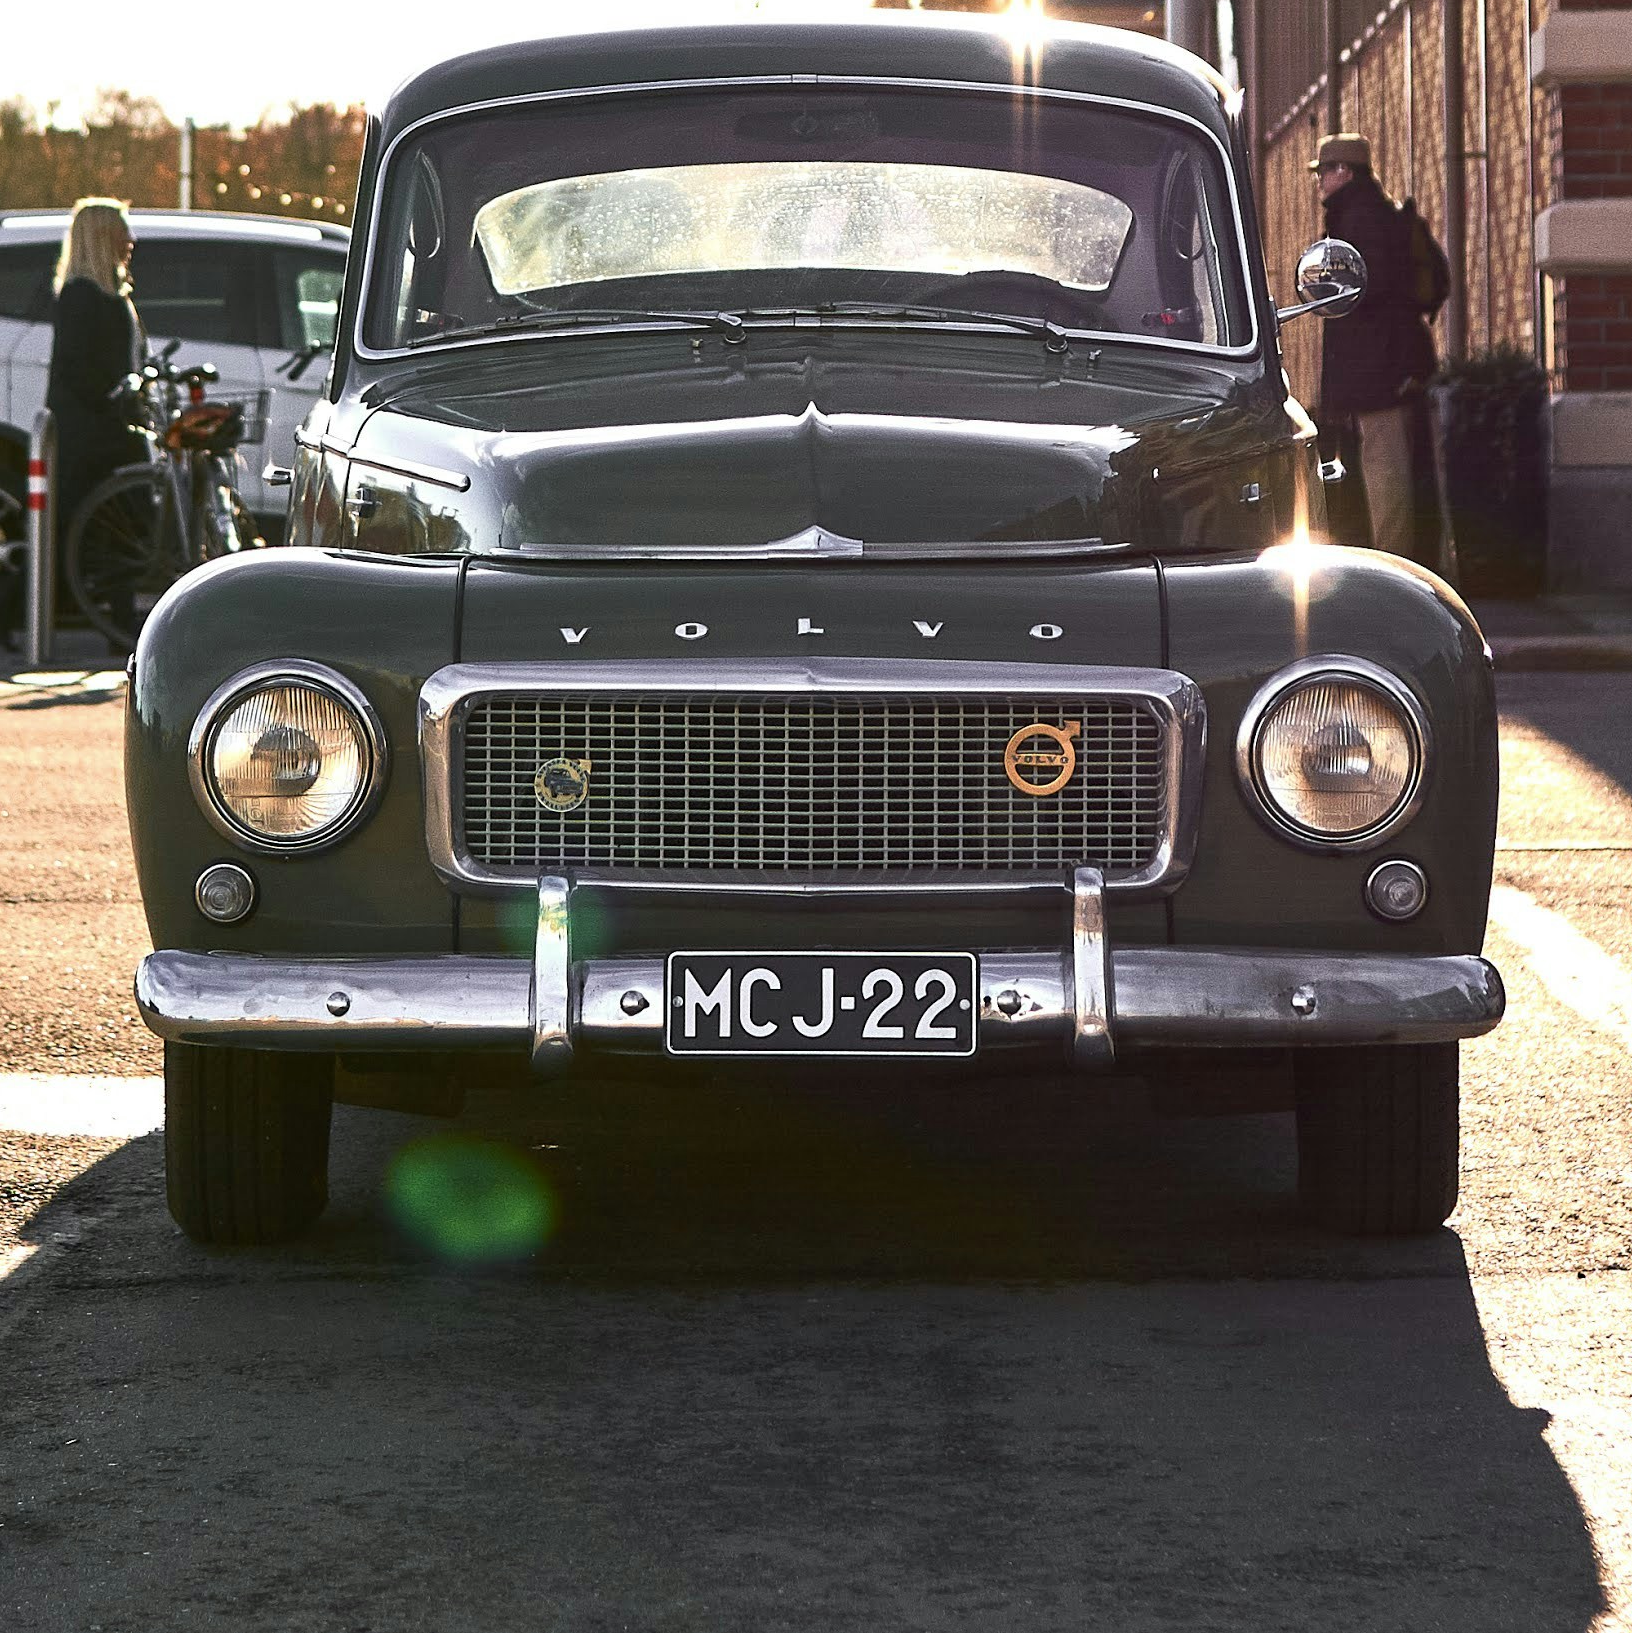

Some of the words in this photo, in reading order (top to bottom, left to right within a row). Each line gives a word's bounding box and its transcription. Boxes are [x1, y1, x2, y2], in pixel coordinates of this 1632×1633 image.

[560, 618, 1064, 643] VOLVO
[1012, 755, 1069, 764] VOLVO
[684, 968, 957, 1039] MCJ-22
